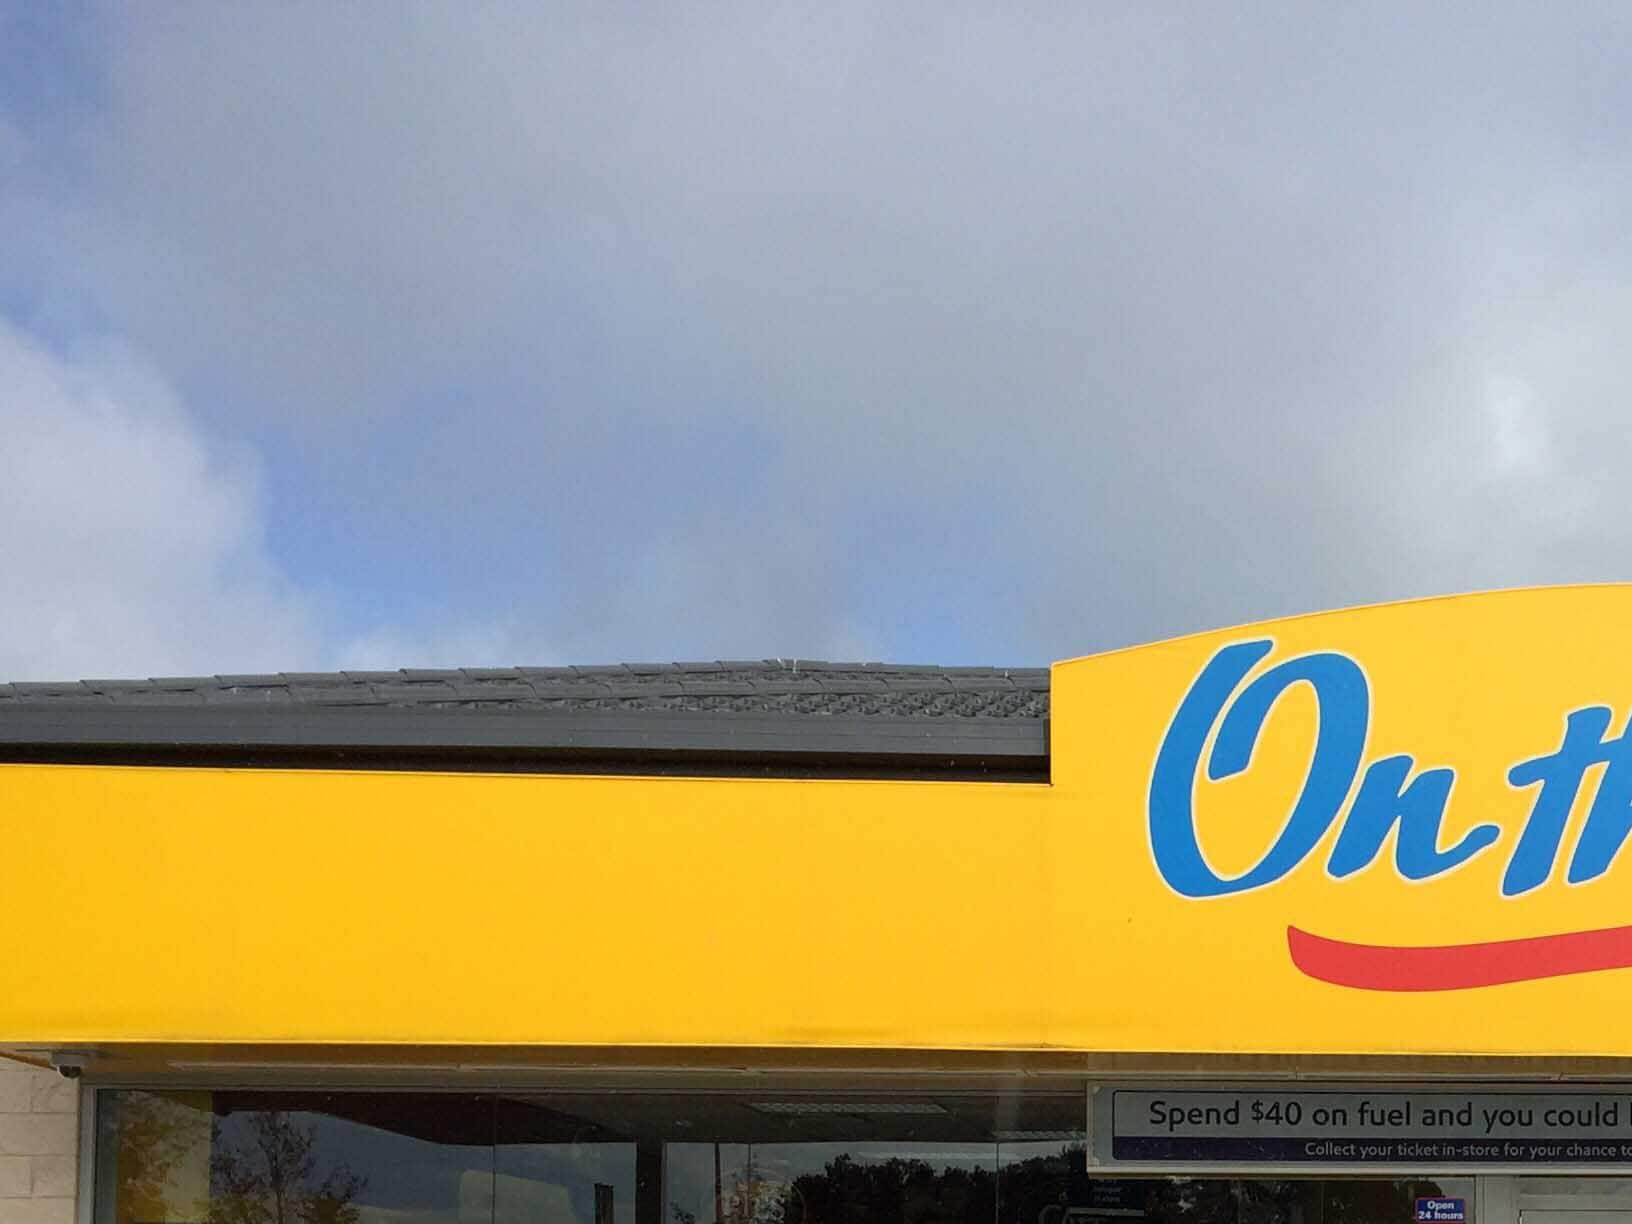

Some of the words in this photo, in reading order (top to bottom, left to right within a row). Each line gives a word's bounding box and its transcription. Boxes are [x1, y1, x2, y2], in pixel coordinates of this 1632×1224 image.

[1146, 638, 1501, 898] On
[1149, 1100, 1240, 1132] Spend
[1250, 1100, 1302, 1126] $40
[1312, 1108, 1347, 1126] on
[1357, 1101, 1411, 1126] fuel
[1422, 1101, 1473, 1127] and
[1482, 1109, 1533, 1134] you
[1543, 1101, 1619, 1127] could
[1305, 1142, 1356, 1156] Collect
[1359, 1146, 1393, 1159] your
[1397, 1142, 1438, 1157] ticket
[1442, 1143, 1499, 1157] in-store
[1503, 1143, 1525, 1157] for
[1529, 1146, 1563, 1160] your
[1566, 1143, 1617, 1157] chance
[1427, 1200, 1455, 1210] Open
[1418, 1210, 1432, 1220] 24
[1434, 1210, 1464, 1220] hours
